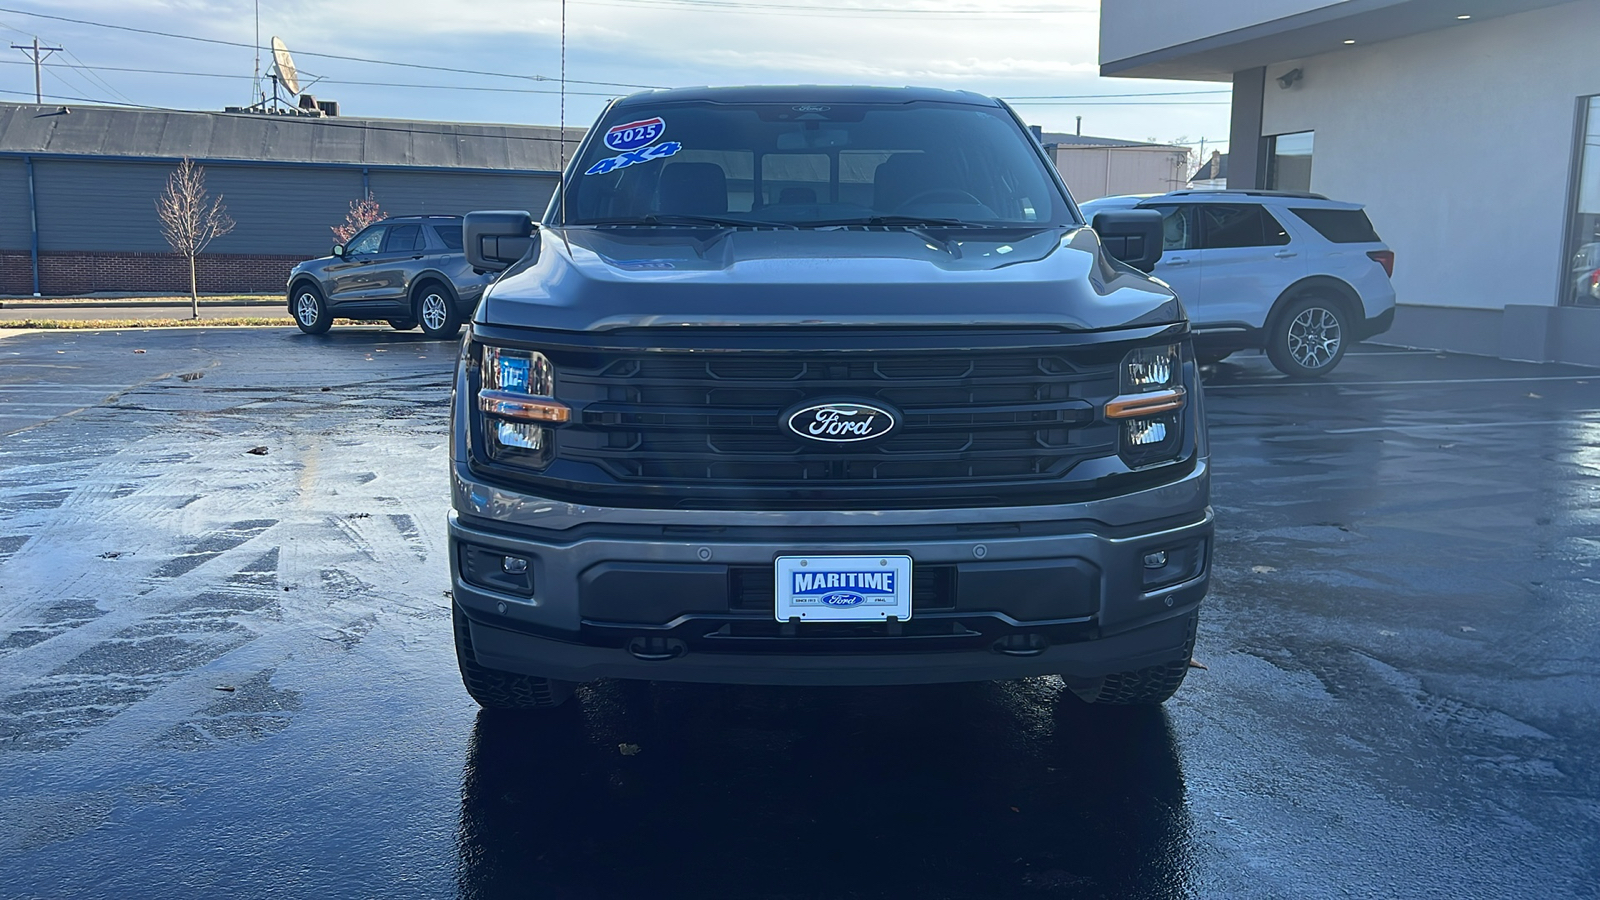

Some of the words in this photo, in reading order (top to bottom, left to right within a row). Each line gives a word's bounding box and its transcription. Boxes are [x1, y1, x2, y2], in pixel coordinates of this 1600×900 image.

[612, 125, 656, 145] 2025
[809, 409, 874, 435] Ford
[795, 573, 893, 593] MARITIME
[828, 594, 858, 605] Ford
